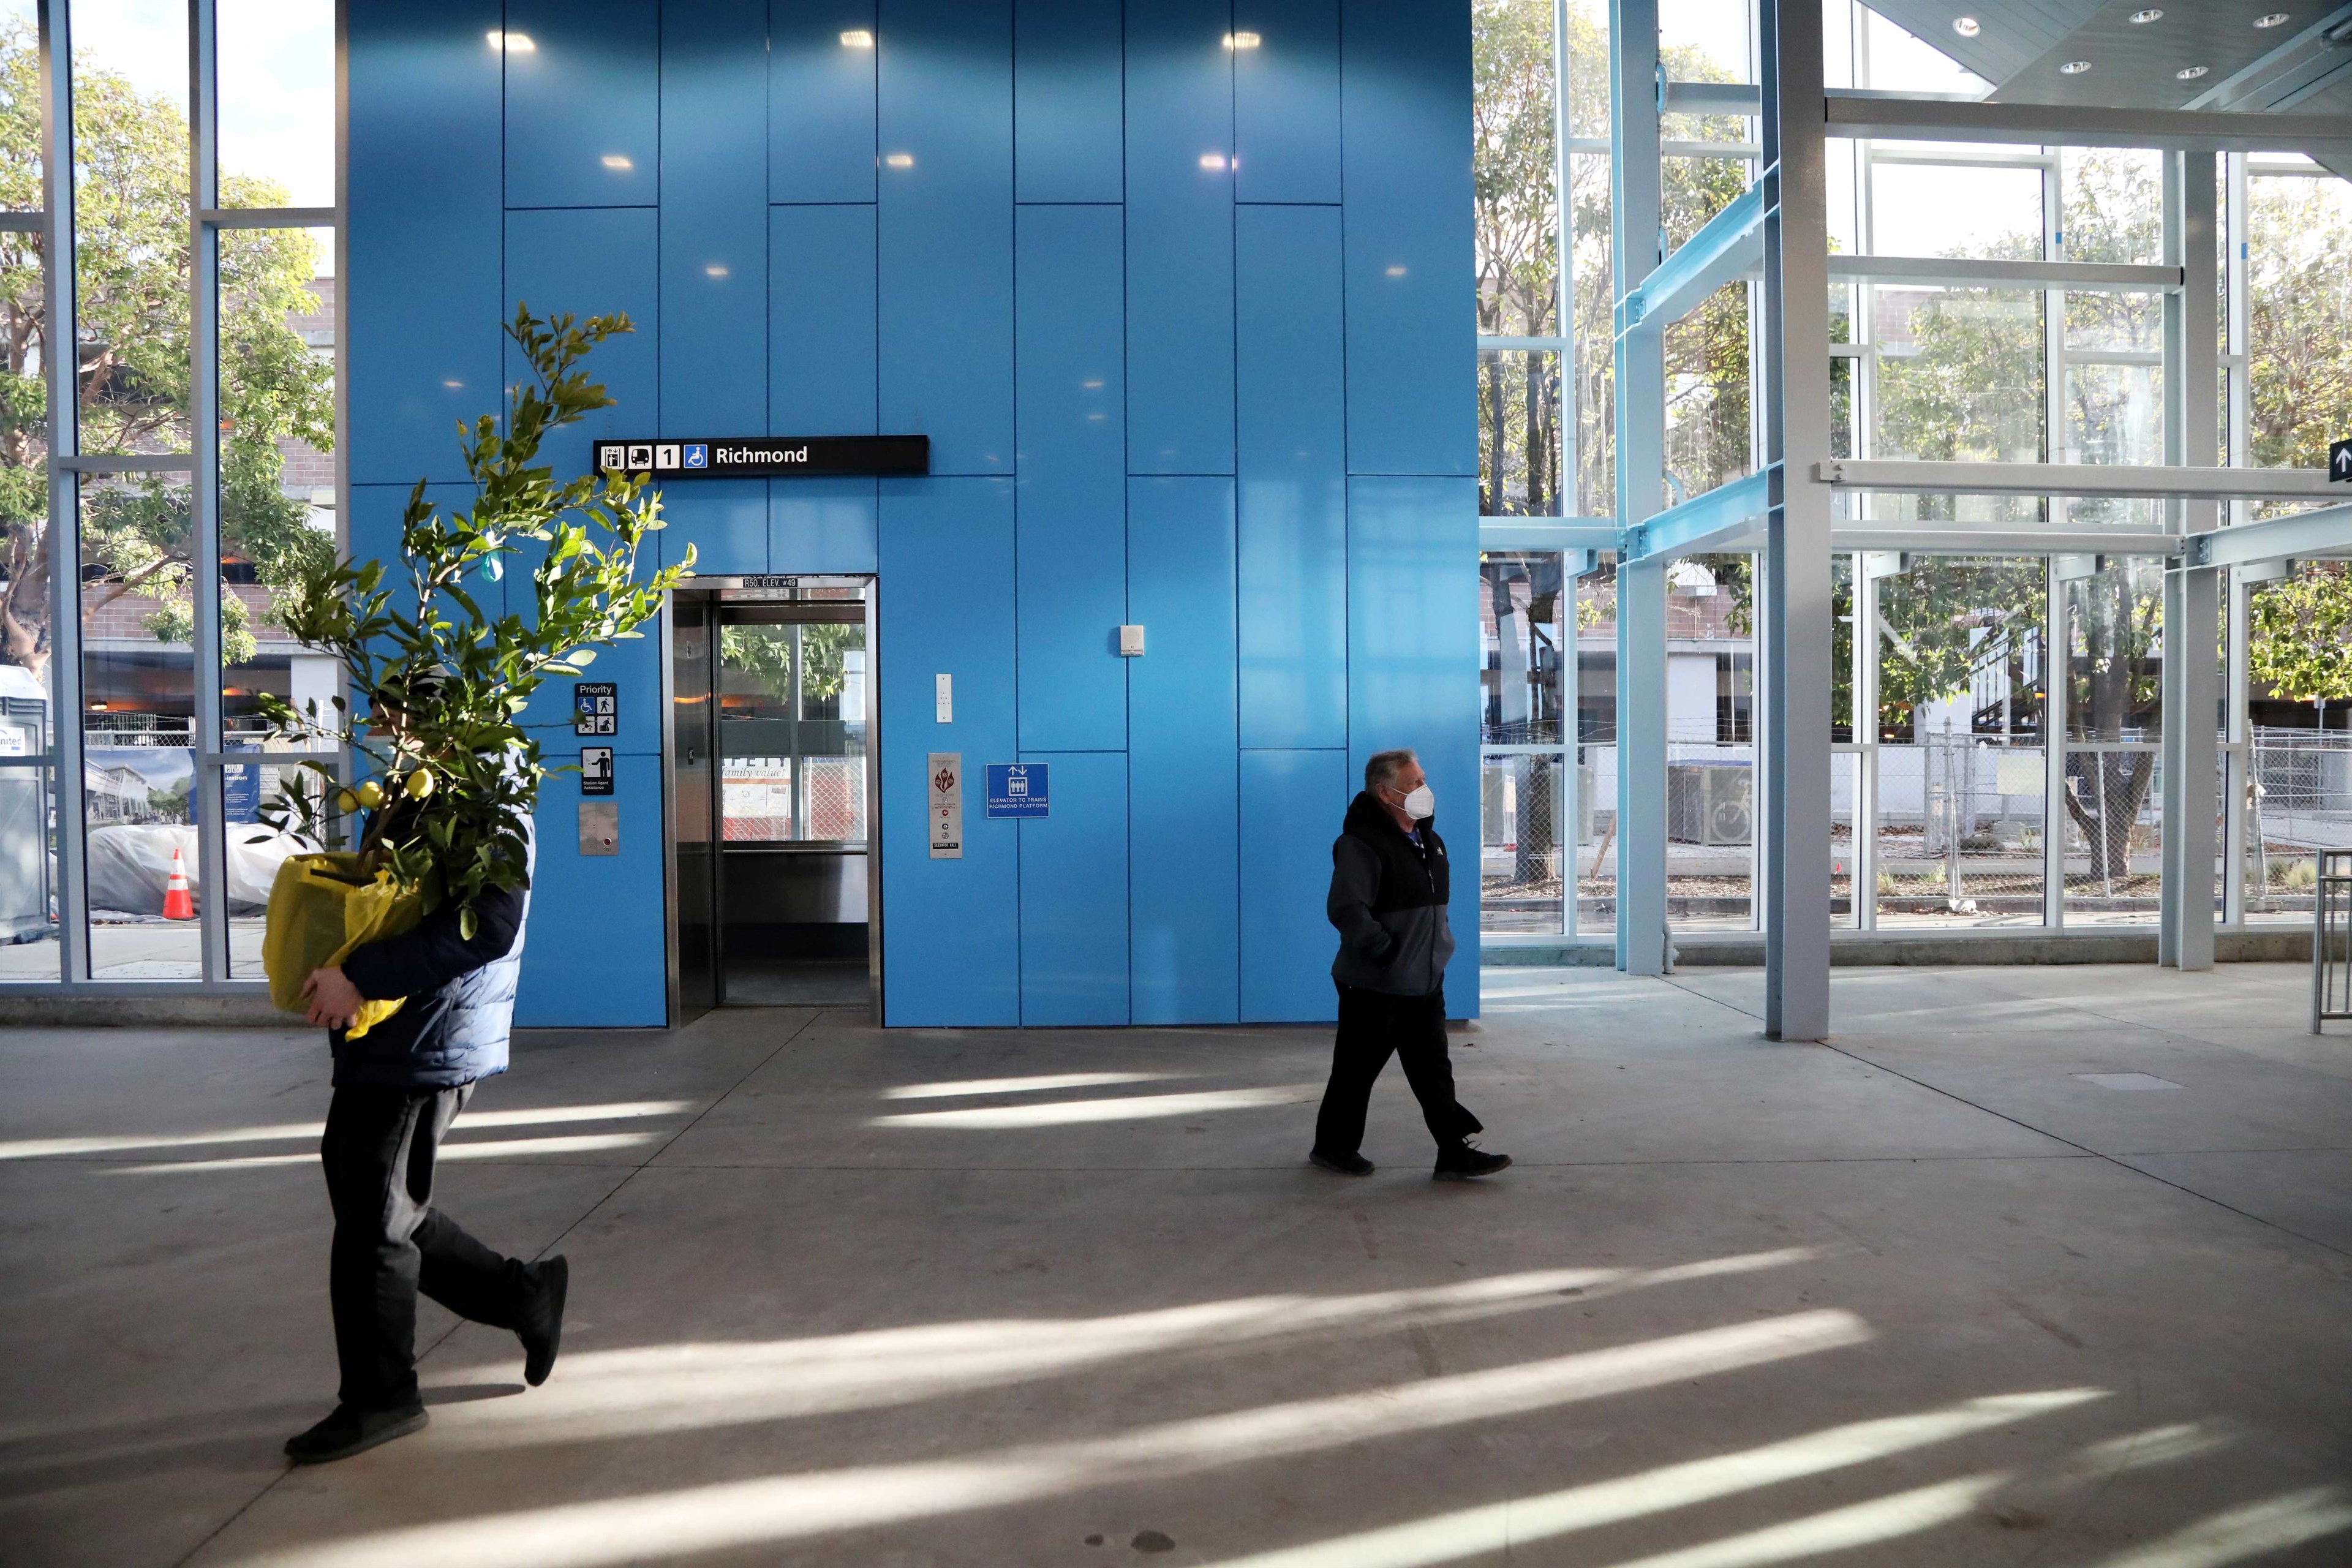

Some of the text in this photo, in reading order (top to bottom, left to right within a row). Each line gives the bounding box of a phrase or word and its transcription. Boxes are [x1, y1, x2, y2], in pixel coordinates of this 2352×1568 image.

[663, 446, 807, 465] 1 Richmond
[579, 685, 612, 695] Priority
[0, 736, 21, 745] nited
